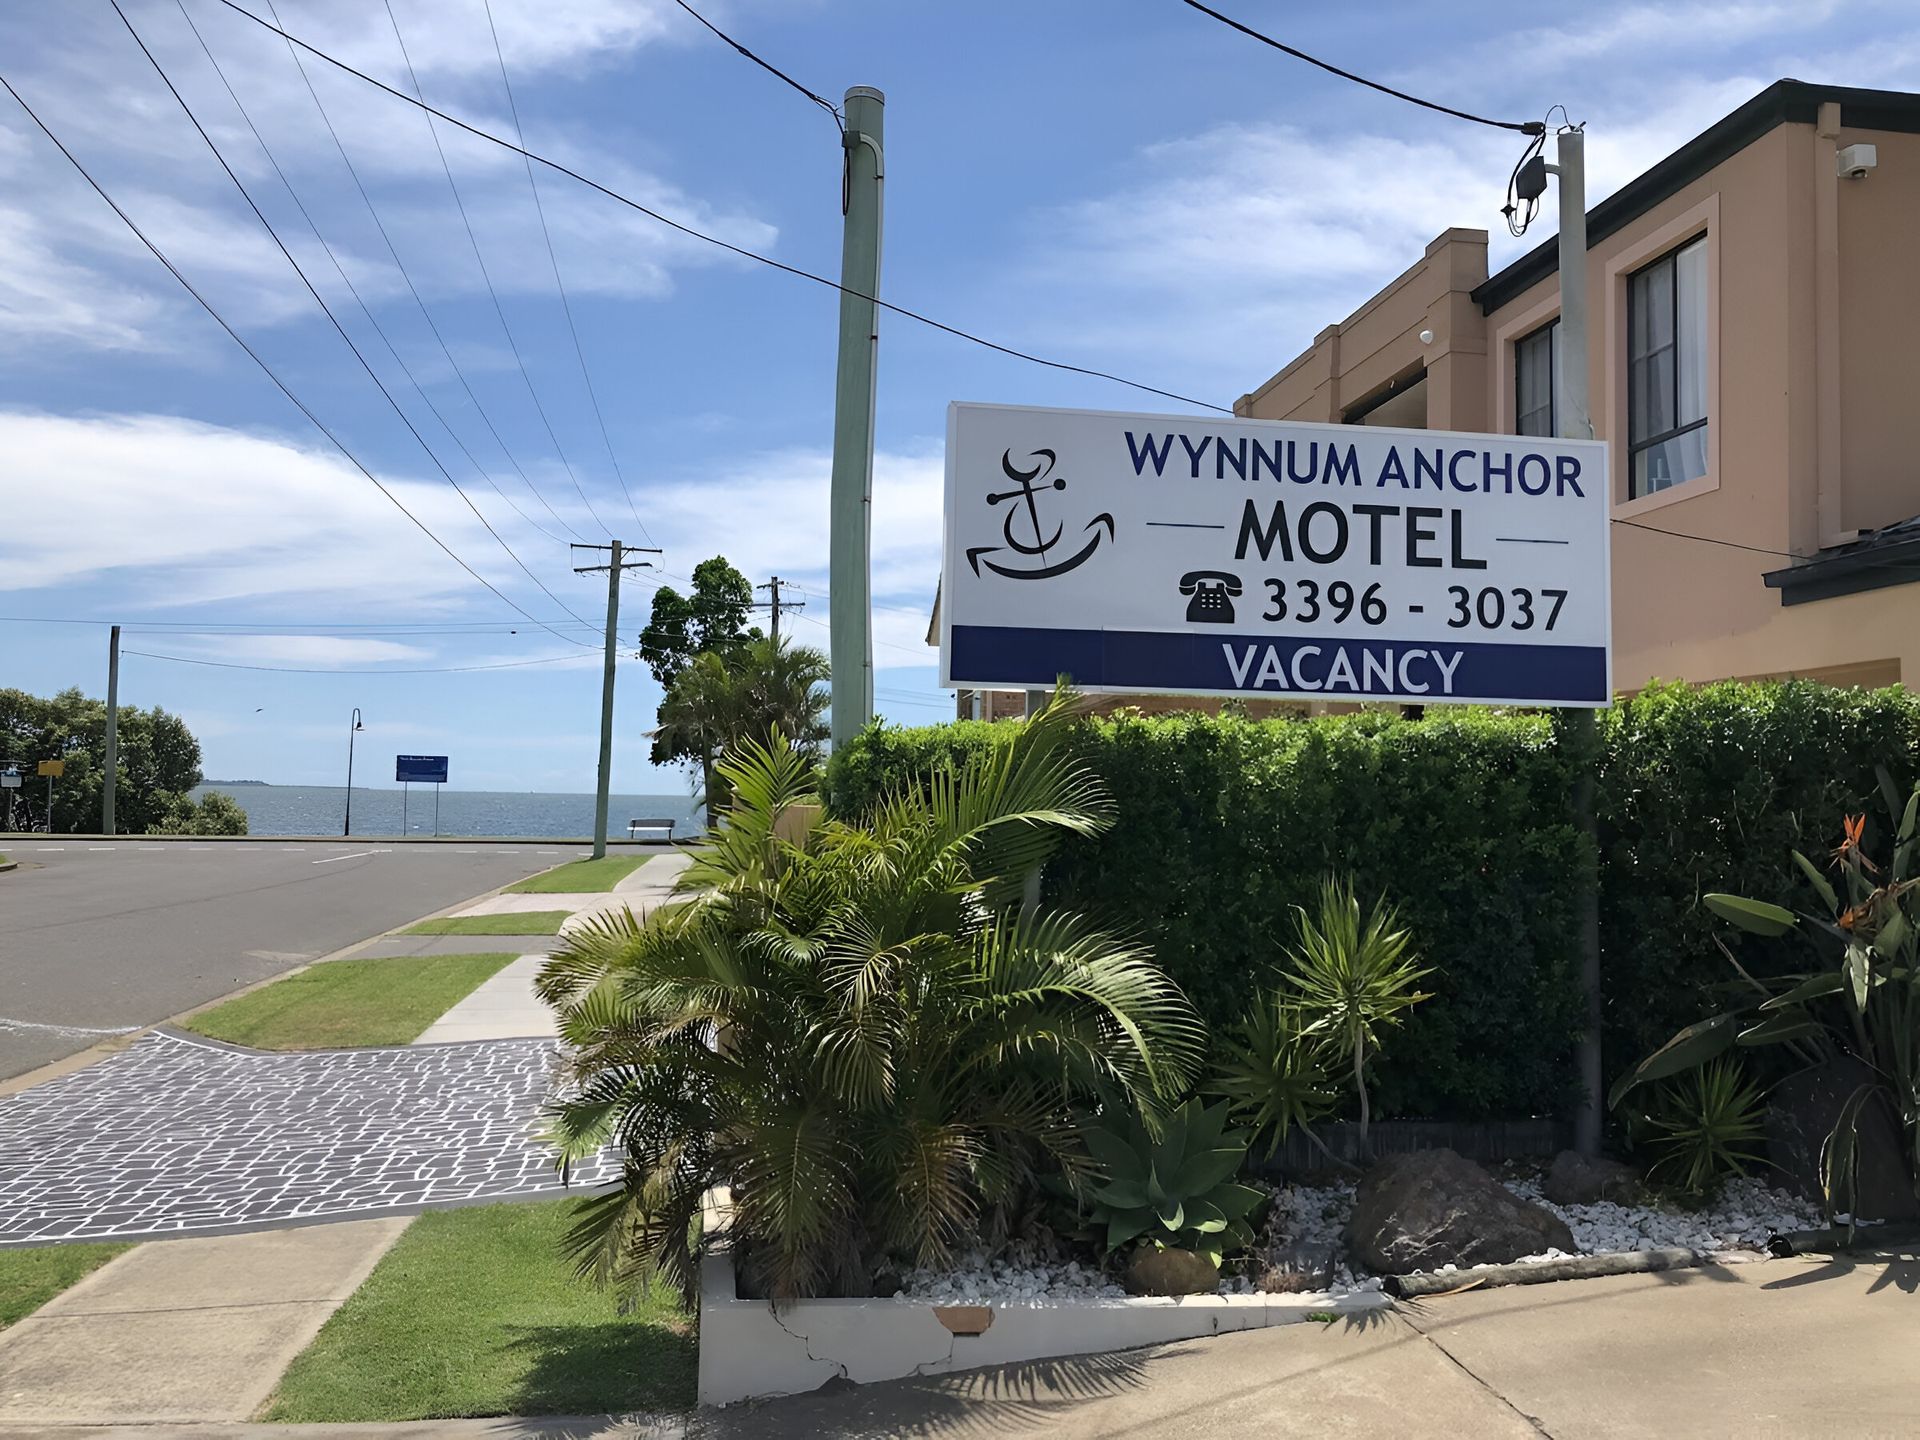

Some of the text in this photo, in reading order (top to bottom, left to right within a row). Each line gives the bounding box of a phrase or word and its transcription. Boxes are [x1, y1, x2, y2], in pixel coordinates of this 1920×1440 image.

[1123, 430, 1586, 498] WYNNUM ANCHOR
[1233, 498, 1489, 570] MOTEL
[1261, 577, 1388, 626] 3396
[1446, 585, 1570, 632] 3037
[1222, 643, 1465, 694] VACANCY
